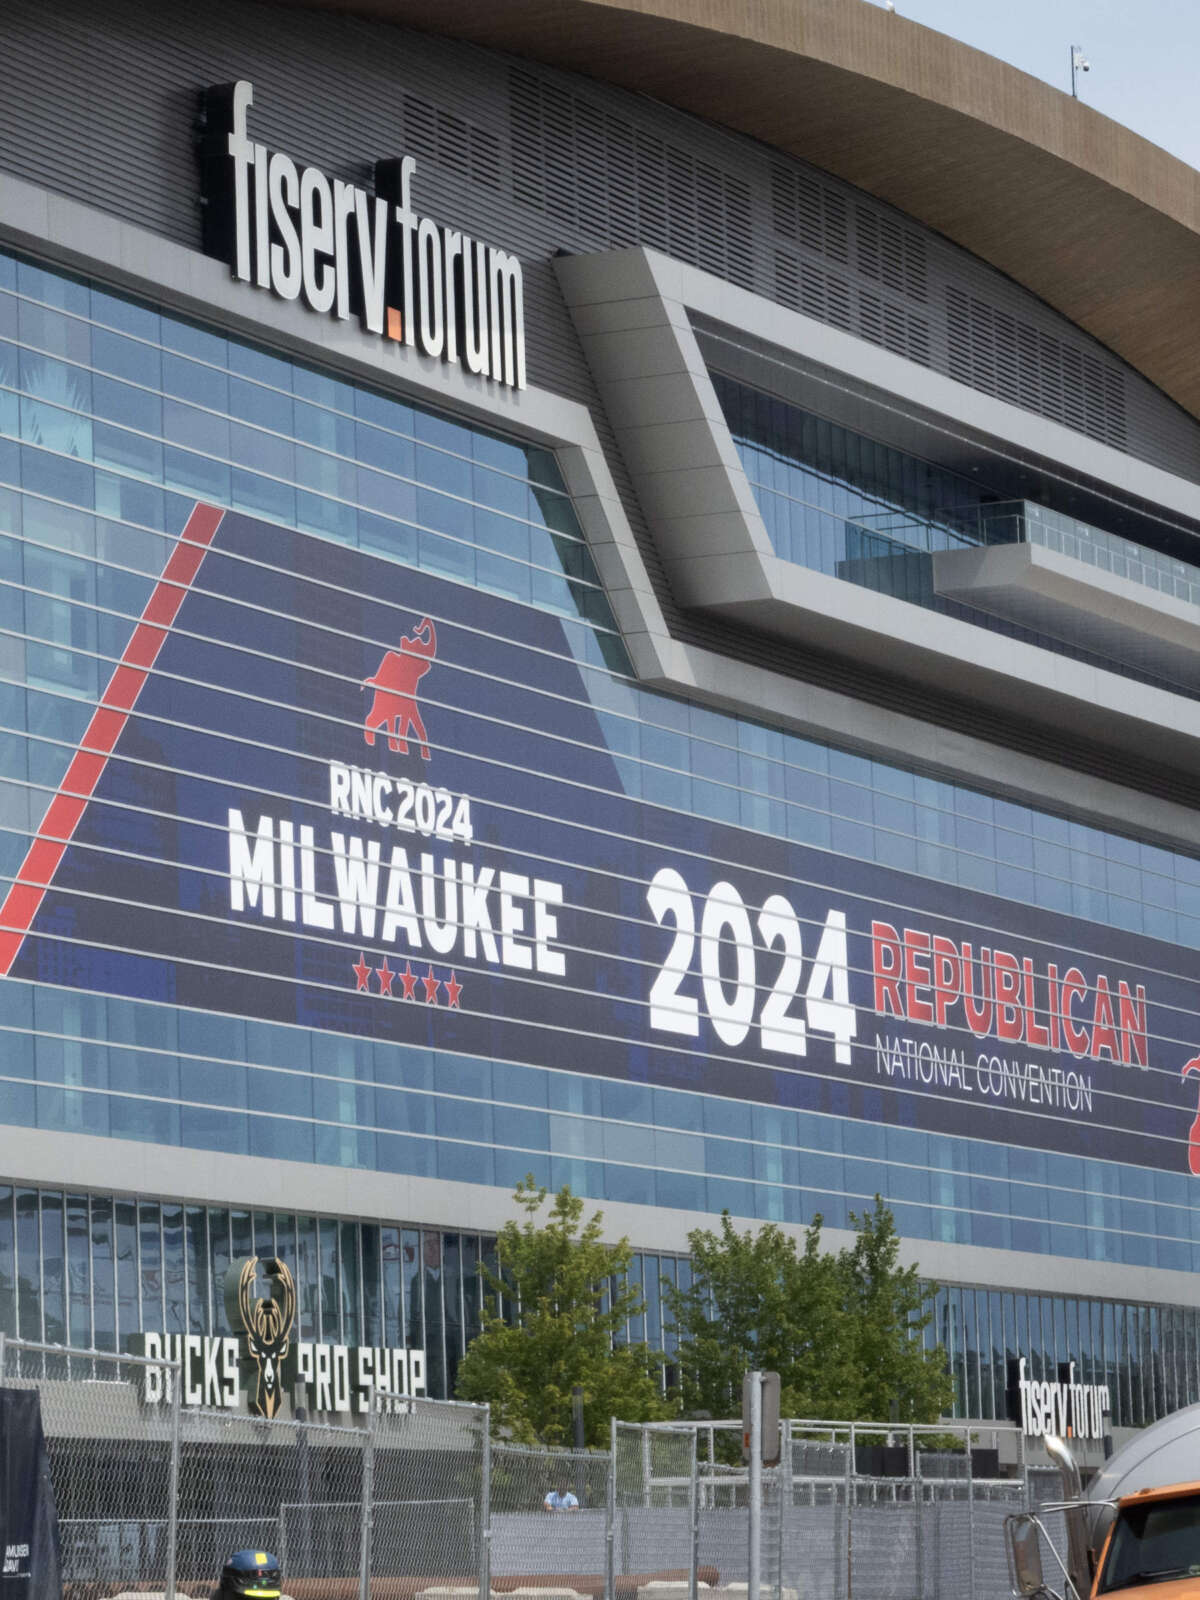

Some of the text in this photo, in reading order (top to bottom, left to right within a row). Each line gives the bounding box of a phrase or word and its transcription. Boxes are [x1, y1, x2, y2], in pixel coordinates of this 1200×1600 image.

[396, 155, 527, 390] forum
[396, 777, 474, 847] 2024
[228, 807, 567, 977] MILWAUKEE
[646, 867, 857, 1066] 2024
[871, 919, 1149, 1071] REPUBLICAN
[875, 1033, 1093, 1113] NATIONAL CONVENTION
[144, 1332, 427, 1415] BUCKS PRO SHOP
[1069, 1361, 1111, 1439] forum
